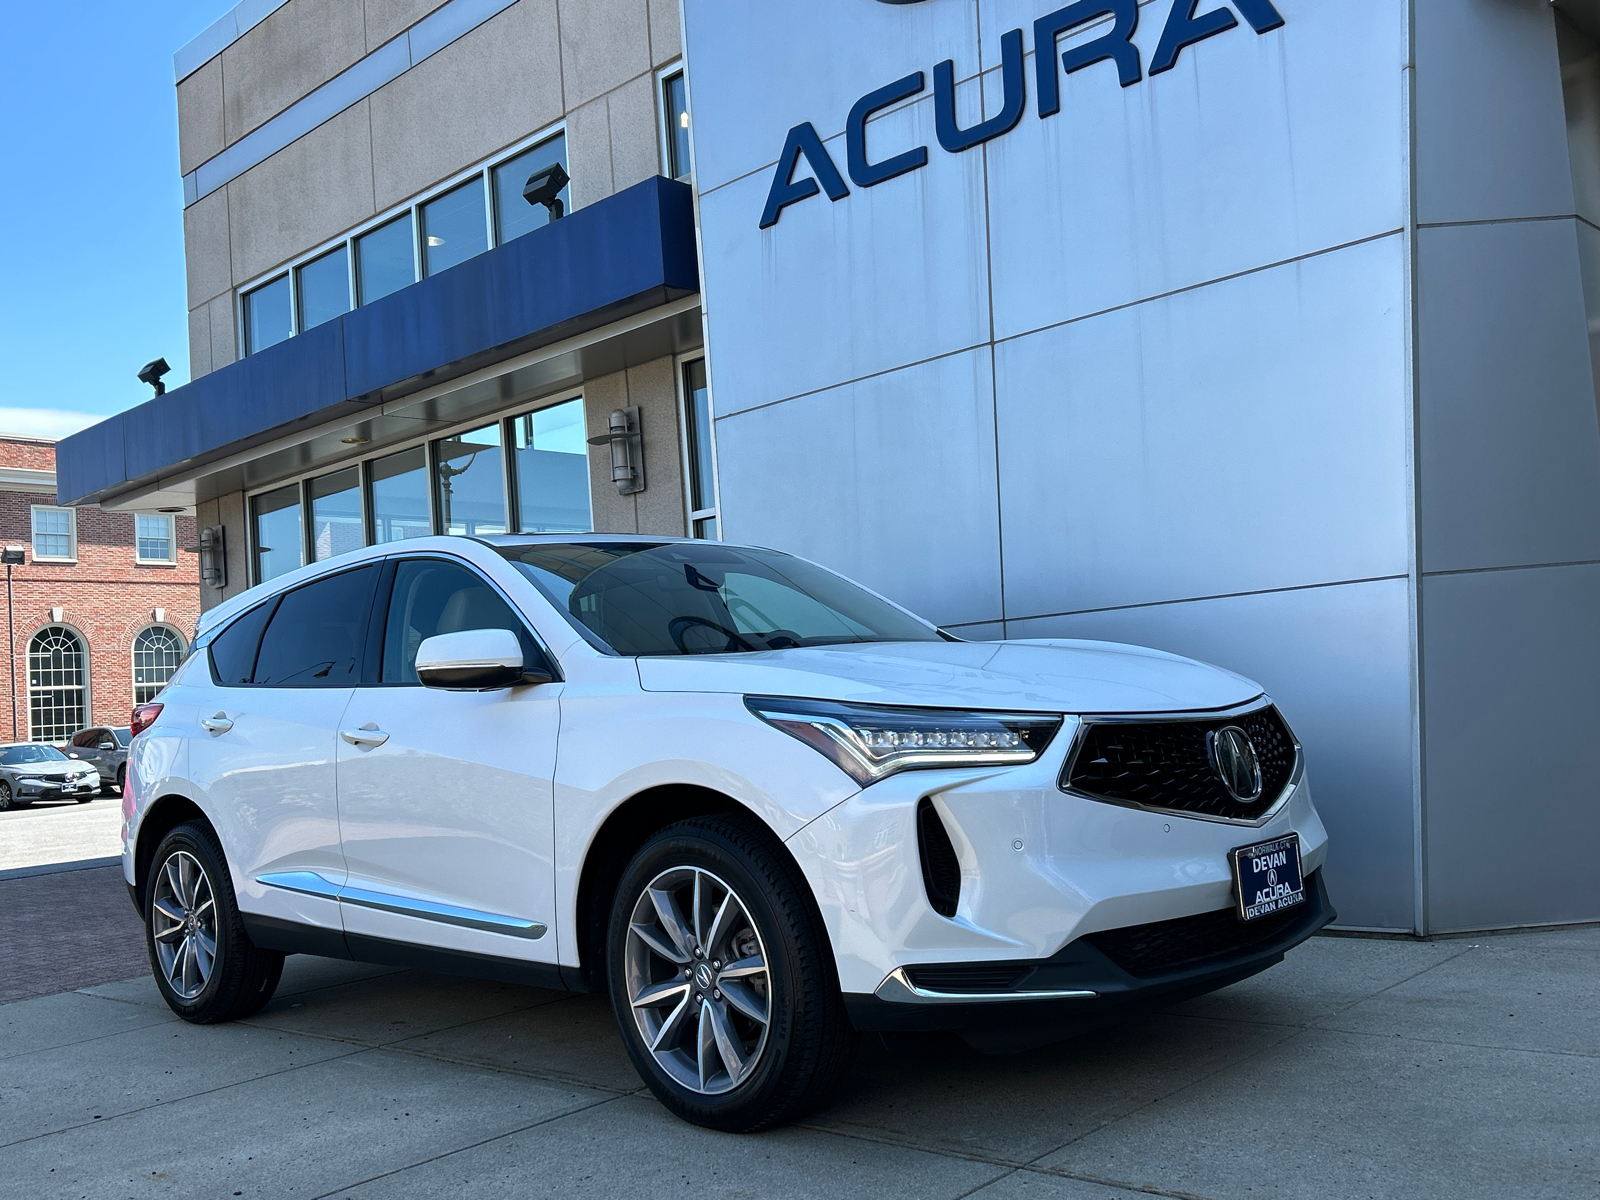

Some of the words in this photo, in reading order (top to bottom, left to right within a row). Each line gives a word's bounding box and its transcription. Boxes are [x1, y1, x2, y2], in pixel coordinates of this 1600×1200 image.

[759, 0, 1285, 229] ACURA
[1253, 851, 1286, 873] DEVAN
[1256, 882, 1291, 904] ACURA
[1249, 901, 1276, 917] DEVAN
[1278, 893, 1303, 909] ACURA
